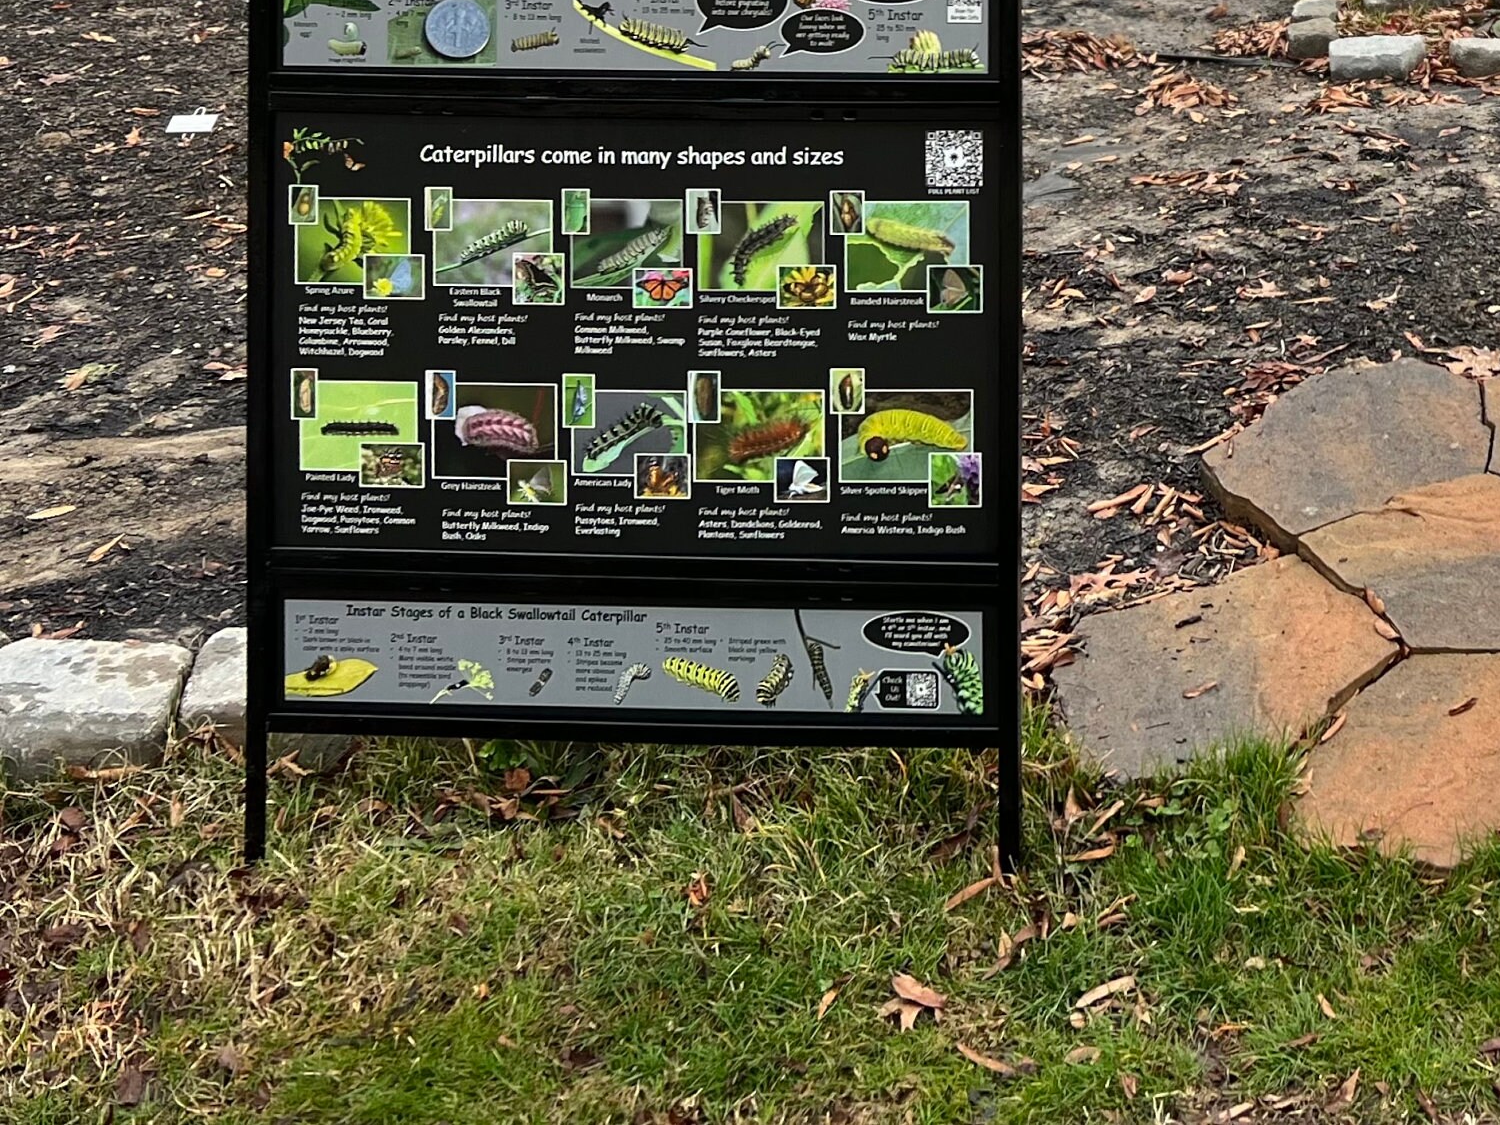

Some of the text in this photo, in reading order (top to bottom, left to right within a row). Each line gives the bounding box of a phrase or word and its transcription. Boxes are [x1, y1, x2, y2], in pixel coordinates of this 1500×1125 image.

[522, 0, 553, 10] Instar
[888, 10, 923, 20] Instar
[419, 144, 844, 170] Caterpillars come in many shapes and sizes
[299, 303, 318, 312] Find
[321, 306, 336, 315] my
[337, 304, 357, 312] host
[439, 313, 458, 321] Find
[461, 315, 475, 324] my
[477, 314, 496, 322] host
[575, 313, 595, 321] Find
[596, 315, 611, 323] my
[613, 313, 633, 321] host
[698, 315, 718, 324] Find
[720, 318, 735, 326] my
[737, 315, 756, 324] host
[848, 320, 868, 328] Find
[870, 322, 885, 331] my
[887, 320, 906, 328] host
[613, 479, 632, 488] Lady
[442, 508, 462, 517] Find
[464, 511, 478, 519] my
[481, 509, 499, 517] host
[575, 503, 595, 512] Find
[597, 505, 612, 514] my
[614, 503, 633, 512] host
[698, 507, 719, 515] Find
[721, 509, 736, 518] my
[738, 507, 757, 516] host
[841, 513, 861, 522] Find
[864, 515, 878, 523] my
[881, 513, 899, 521] host
[346, 605, 648, 625] Instar Stages of a Black Swallowtail Caterpillar
[674, 623, 710, 634] Instar
[407, 634, 438, 644] Instar
[515, 635, 545, 646] Instar
[584, 638, 614, 648] Instar
